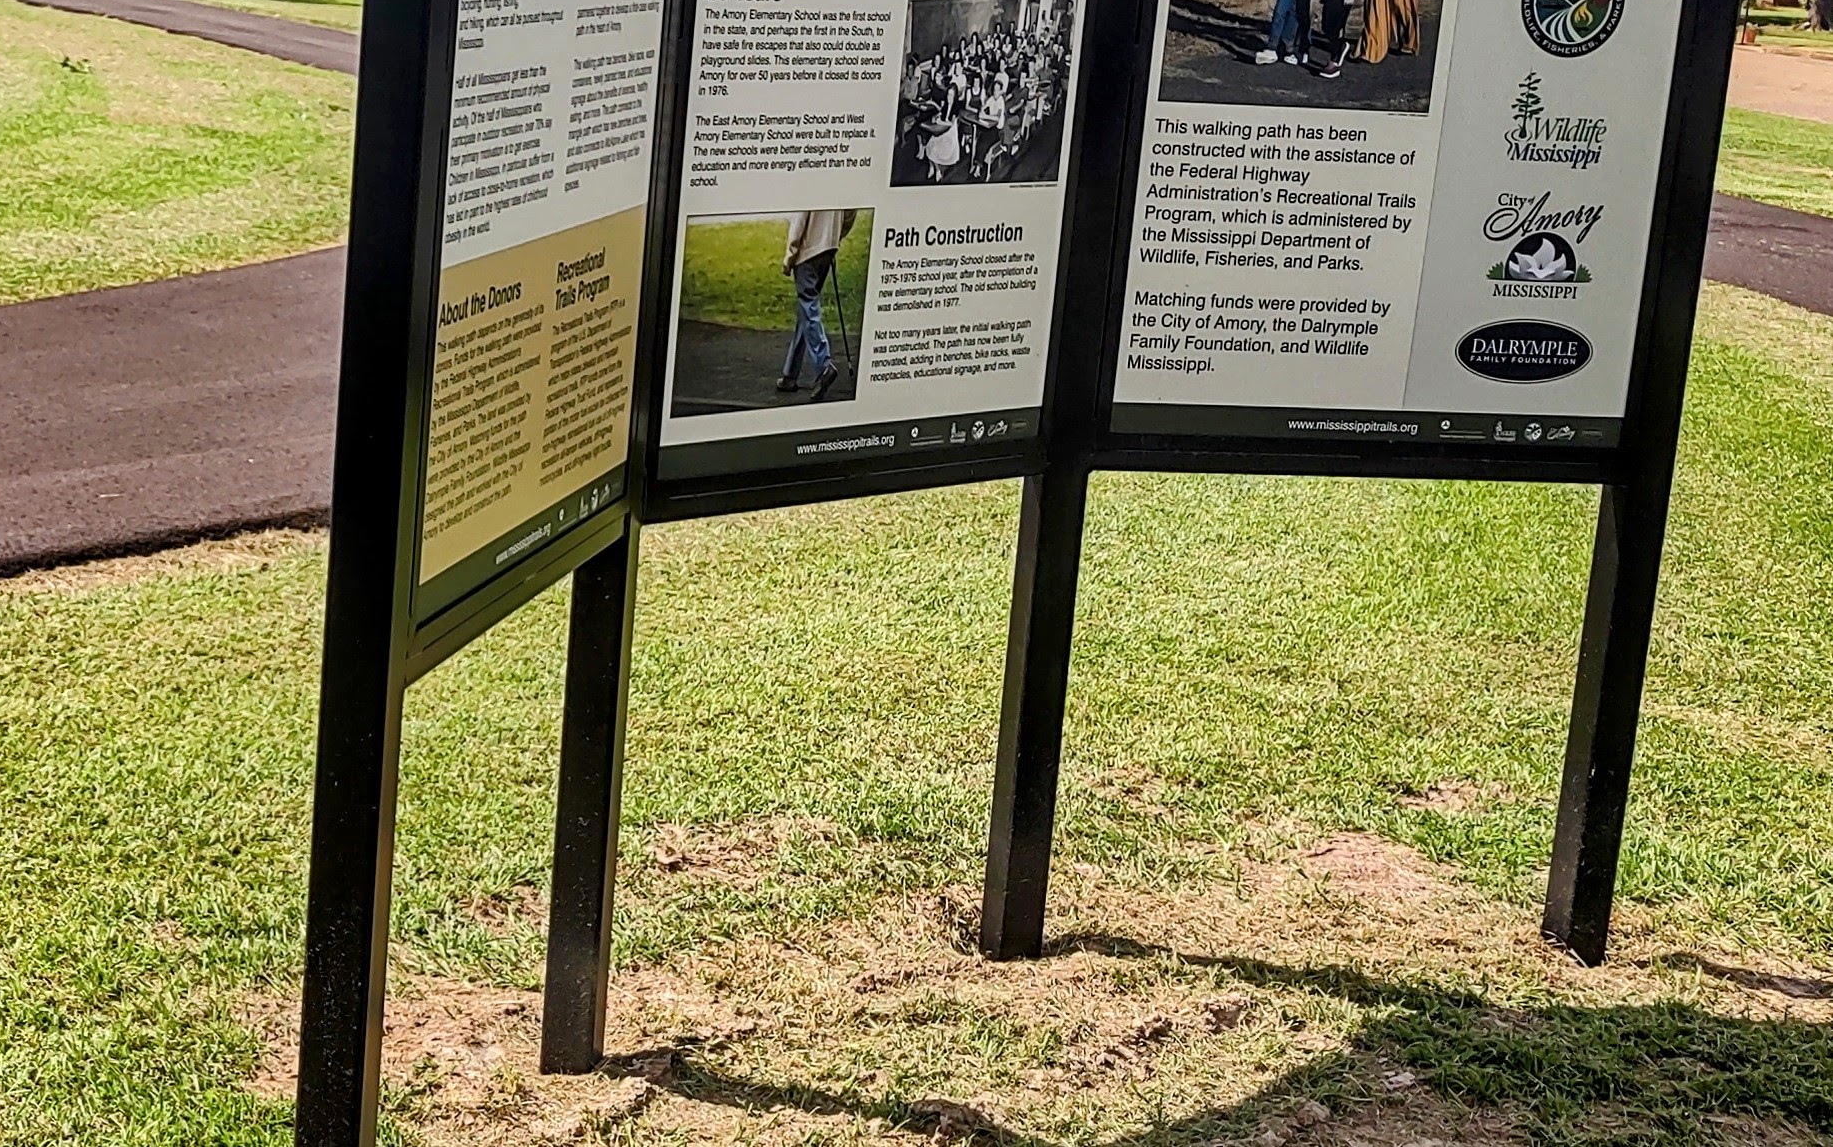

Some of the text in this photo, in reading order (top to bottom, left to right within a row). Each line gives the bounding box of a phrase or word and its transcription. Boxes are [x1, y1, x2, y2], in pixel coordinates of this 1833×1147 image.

[706, 9, 720, 19] The
[722, 9, 747, 22] Amory
[749, 9, 792, 22] Elementary
[795, 10, 821, 20] School
[839, 12, 850, 21] the
[853, 11, 865, 21] first
[867, 12, 891, 21] school
[1542, 40, 1599, 54] FISHERIES,
[1599, 33, 1607, 41] &
[1155, 118, 1366, 141] This walking path has been
[1534, 117, 1607, 148] Wildlife
[1153, 143, 1415, 165] constructed with the assistance of
[1510, 143, 1602, 169] Mississippi
[1498, 193, 1527, 210] City
[1483, 191, 1604, 244] Amory
[885, 223, 1023, 248] Path Construction
[557, 247, 605, 284] Recreational
[556, 276, 609, 310] Trails Program
[1493, 284, 1577, 299] MISSISSIPPI
[439, 282, 521, 328] About the Donors
[1471, 339, 1577, 356] DALRYMPLE
[1289, 420, 1418, 435] www.mississippitrails.org
[797, 436, 894, 454] www.mississippitrails.org
